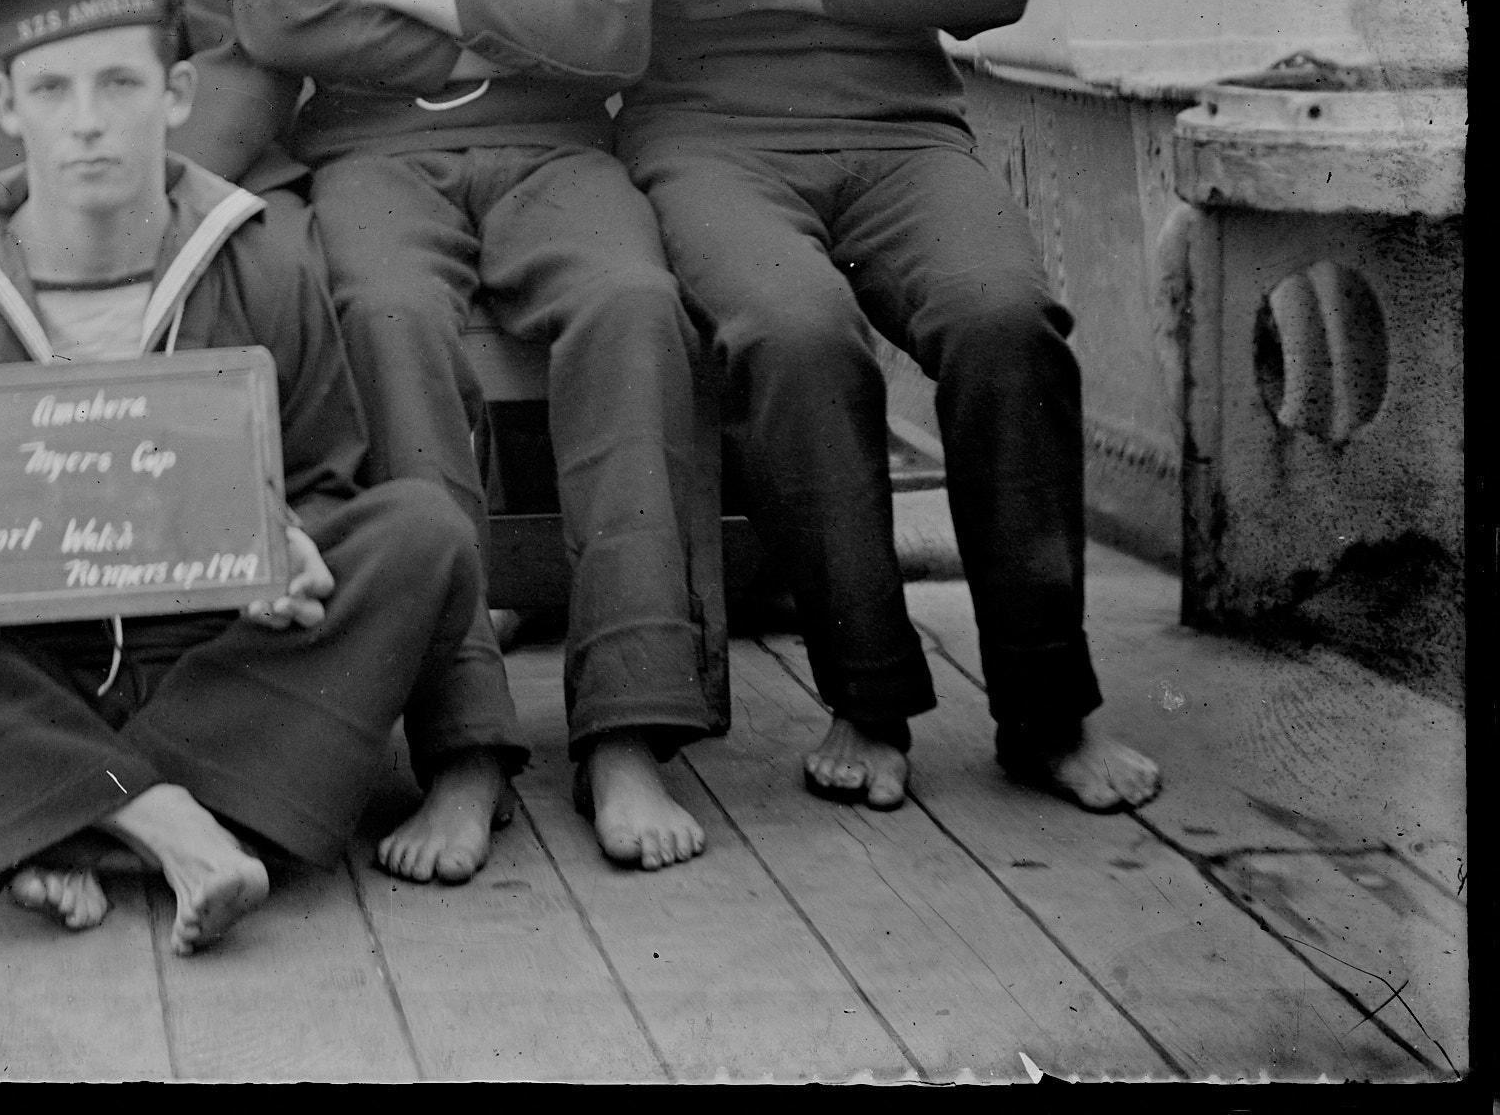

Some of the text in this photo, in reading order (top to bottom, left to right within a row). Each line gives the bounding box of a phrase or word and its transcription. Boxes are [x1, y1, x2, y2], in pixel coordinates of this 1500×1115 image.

[130, 439, 177, 479] Cup
[172, 560, 205, 590] up
[206, 552, 260, 584] 1919
